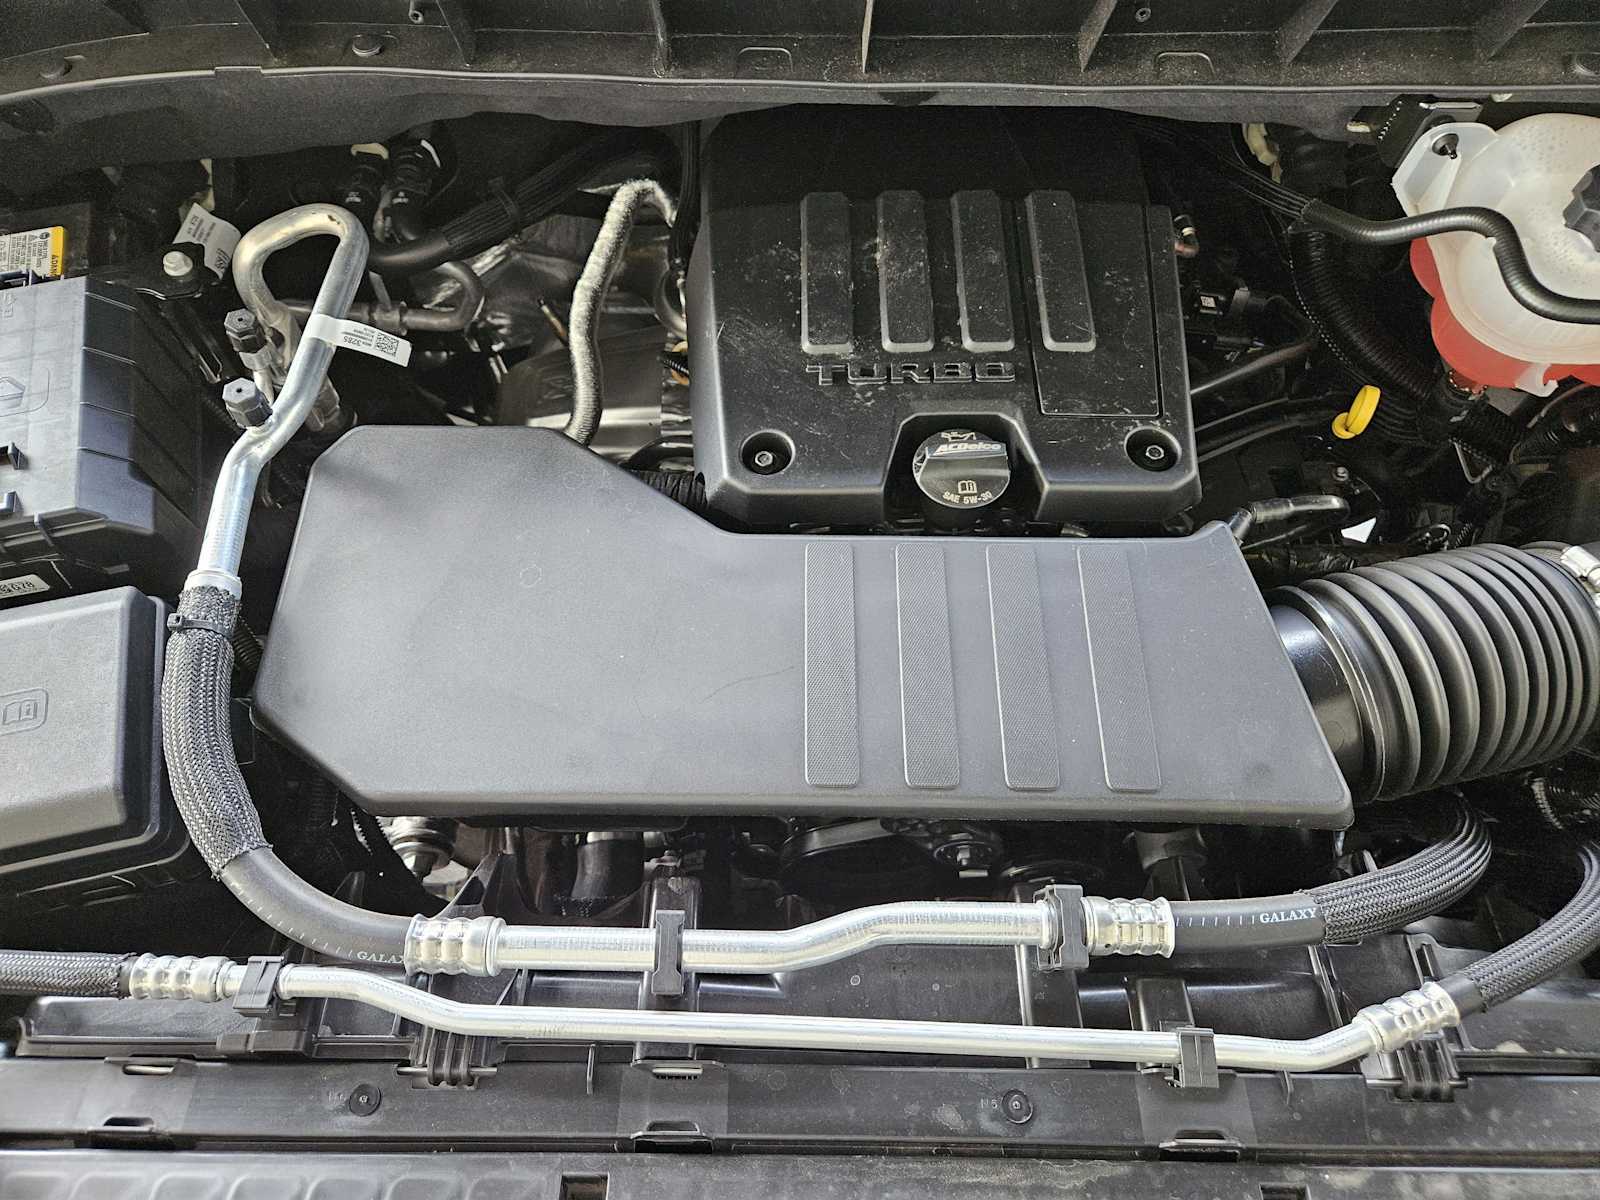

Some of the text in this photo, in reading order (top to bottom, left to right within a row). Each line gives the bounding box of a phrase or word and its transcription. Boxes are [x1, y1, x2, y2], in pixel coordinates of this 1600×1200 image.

[806, 362, 1016, 386] TURBO
[933, 442, 1002, 456] ACDelco
[942, 490, 993, 505] SAE 5W-30
[1259, 907, 1317, 924] GALAXY
